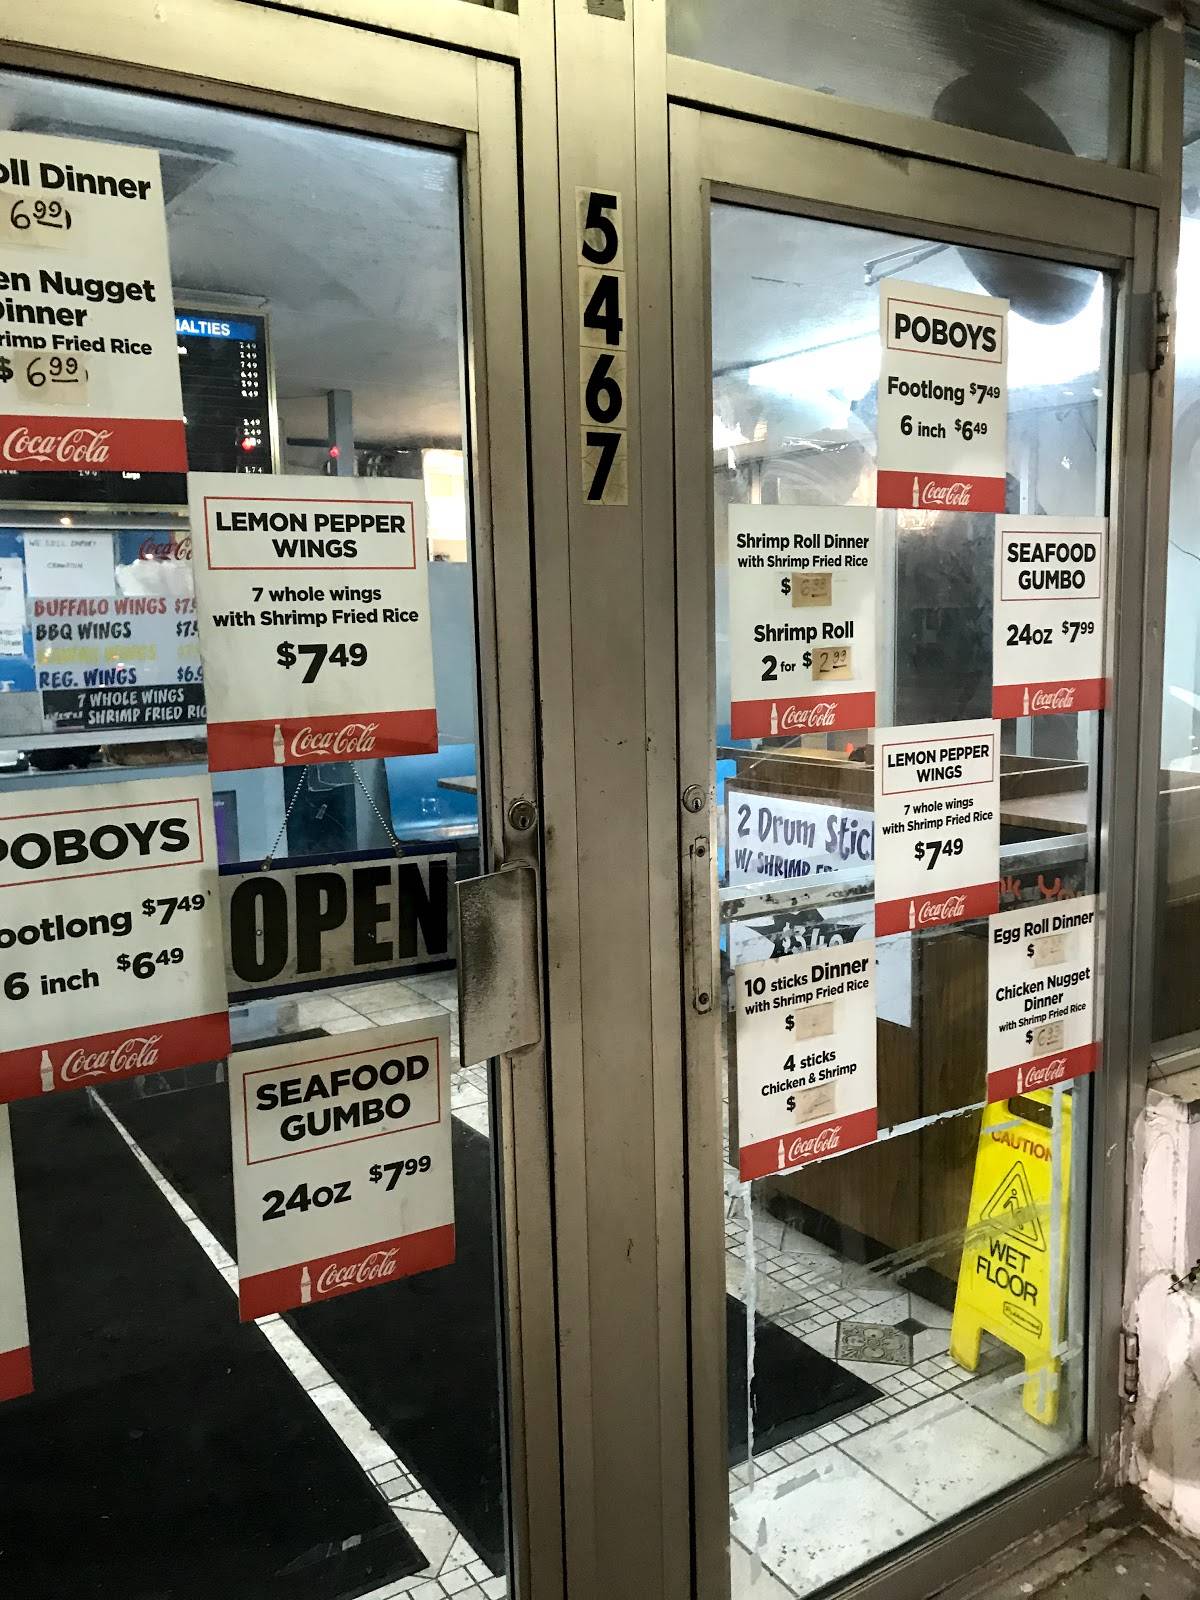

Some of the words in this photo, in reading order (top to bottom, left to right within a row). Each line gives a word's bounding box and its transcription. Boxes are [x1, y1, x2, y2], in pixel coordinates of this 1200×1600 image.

[40, 162, 151, 201] Dinner
[39, 269, 156, 304] Nugget
[53, 335, 105, 353] Fried
[111, 338, 153, 356] Rice
[895, 312, 996, 352] POBOYS
[888, 376, 965, 405] Footlong
[970, 383, 1000, 404] $749
[901, 415, 913, 436] 6
[918, 422, 946, 438] inch
[954, 418, 987, 441] $649
[3, 427, 113, 464] Coca-Cola
[922, 481, 973, 506] Coca-Cola
[216, 512, 307, 533] LEMON
[315, 514, 406, 533] PEPPER
[272, 539, 357, 558] WINGS
[736, 533, 790, 551] Shrimp
[794, 534, 821, 549] Roll
[825, 535, 870, 550] Dinner
[1007, 543, 1096, 563] SEAFOOD
[737, 555, 765, 568] with
[767, 555, 810, 571] Shrimp
[813, 555, 841, 568] Fried
[845, 555, 868, 568] Rice
[781, 577, 792, 596] $
[1018, 570, 1086, 590] GUMBO
[34, 600, 109, 618] BUFFALO
[115, 598, 167, 616] WINGS
[252, 588, 264, 602] 7
[269, 586, 324, 602] whole
[329, 588, 381, 605] wings
[213, 610, 255, 625] with
[260, 608, 327, 626] Shrimp
[332, 605, 377, 623] Fried
[382, 603, 419, 621] Rice
[36, 624, 72, 641] BBQ
[78, 621, 132, 639] WINGS
[754, 624, 818, 643] Shrimp
[822, 621, 854, 640] Roll
[1006, 624, 1053, 646] 24oz
[1061, 620, 1095, 643] $799
[277, 641, 367, 684] $749
[761, 655, 778, 681] 2
[780, 661, 796, 672] for
[802, 651, 812, 669] $
[40, 671, 78, 689] REG.
[84, 668, 137, 688] WINGS
[78, 693, 85, 708] 7
[91, 691, 138, 708] WHOLE
[142, 688, 185, 705] WINGS
[1032, 687, 1076, 711] Coca-Cola
[88, 707, 141, 725] SHRIMP
[145, 704, 183, 721] FRIED
[781, 702, 838, 730] Coca-Cola
[291, 723, 380, 758] Coca-Cola
[888, 750, 936, 768] LEMON
[939, 744, 989, 762] PEPPER
[917, 765, 962, 782] WINGS
[904, 805, 911, 816] 7
[913, 802, 943, 815] whole
[945, 798, 974, 812] wings
[738, 804, 752, 838] 2
[759, 807, 816, 848] Drum
[882, 821, 905, 835] with
[907, 817, 943, 832] Shrimp
[946, 812, 970, 826] Fried
[973, 811, 993, 822] Rice
[0, 818, 190, 869] OBOYS
[914, 838, 964, 871] $749
[735, 848, 753, 873] W/
[142, 894, 206, 925] $749
[231, 859, 449, 983] OPEN
[918, 894, 968, 923] Coca-Cola
[994, 926, 1021, 945] Egg
[1024, 918, 1049, 939] Roll
[1052, 911, 1094, 930] Dinner
[1027, 943, 1035, 958] $
[4, 972, 29, 1000] 6
[41, 969, 100, 996] inch
[117, 947, 184, 979] $649
[744, 976, 766, 997] 10
[770, 973, 808, 992] sticks
[811, 958, 869, 983] Dinner
[996, 979, 1044, 1002] Chicken
[1047, 967, 1090, 989] Nugget
[745, 1001, 770, 1015] with
[773, 991, 813, 1009] Shrimp
[816, 984, 844, 999] Fried
[847, 978, 869, 992] Rice
[1024, 991, 1064, 1013] Dinner
[785, 1014, 795, 1032] $
[999, 1020, 1017, 1033] with
[1018, 1012, 1047, 1028] Shrimp
[1049, 1006, 1069, 1020] Fried
[1070, 1002, 1086, 1013] Rice
[1025, 1030, 1034, 1045] $
[61, 1035, 164, 1081] Coca-Cola
[783, 1054, 796, 1072] 4
[800, 1049, 836, 1069] sticks
[256, 1055, 429, 1112] SEAFOOD
[761, 1075, 805, 1097] Chicken
[808, 1072, 817, 1084] &
[818, 1062, 857, 1082] Shrimp
[1025, 1058, 1067, 1088] Coca-Cola
[786, 1095, 796, 1112] $
[281, 1093, 411, 1142] GUMBO
[788, 1126, 842, 1162] Coca-Cola
[262, 1181, 352, 1222] 24oz
[369, 1155, 432, 1192] $799
[988, 1236, 1031, 1274] WET
[318, 1247, 401, 1294] Coca-Cola
[976, 1255, 1039, 1307] FLOOR
